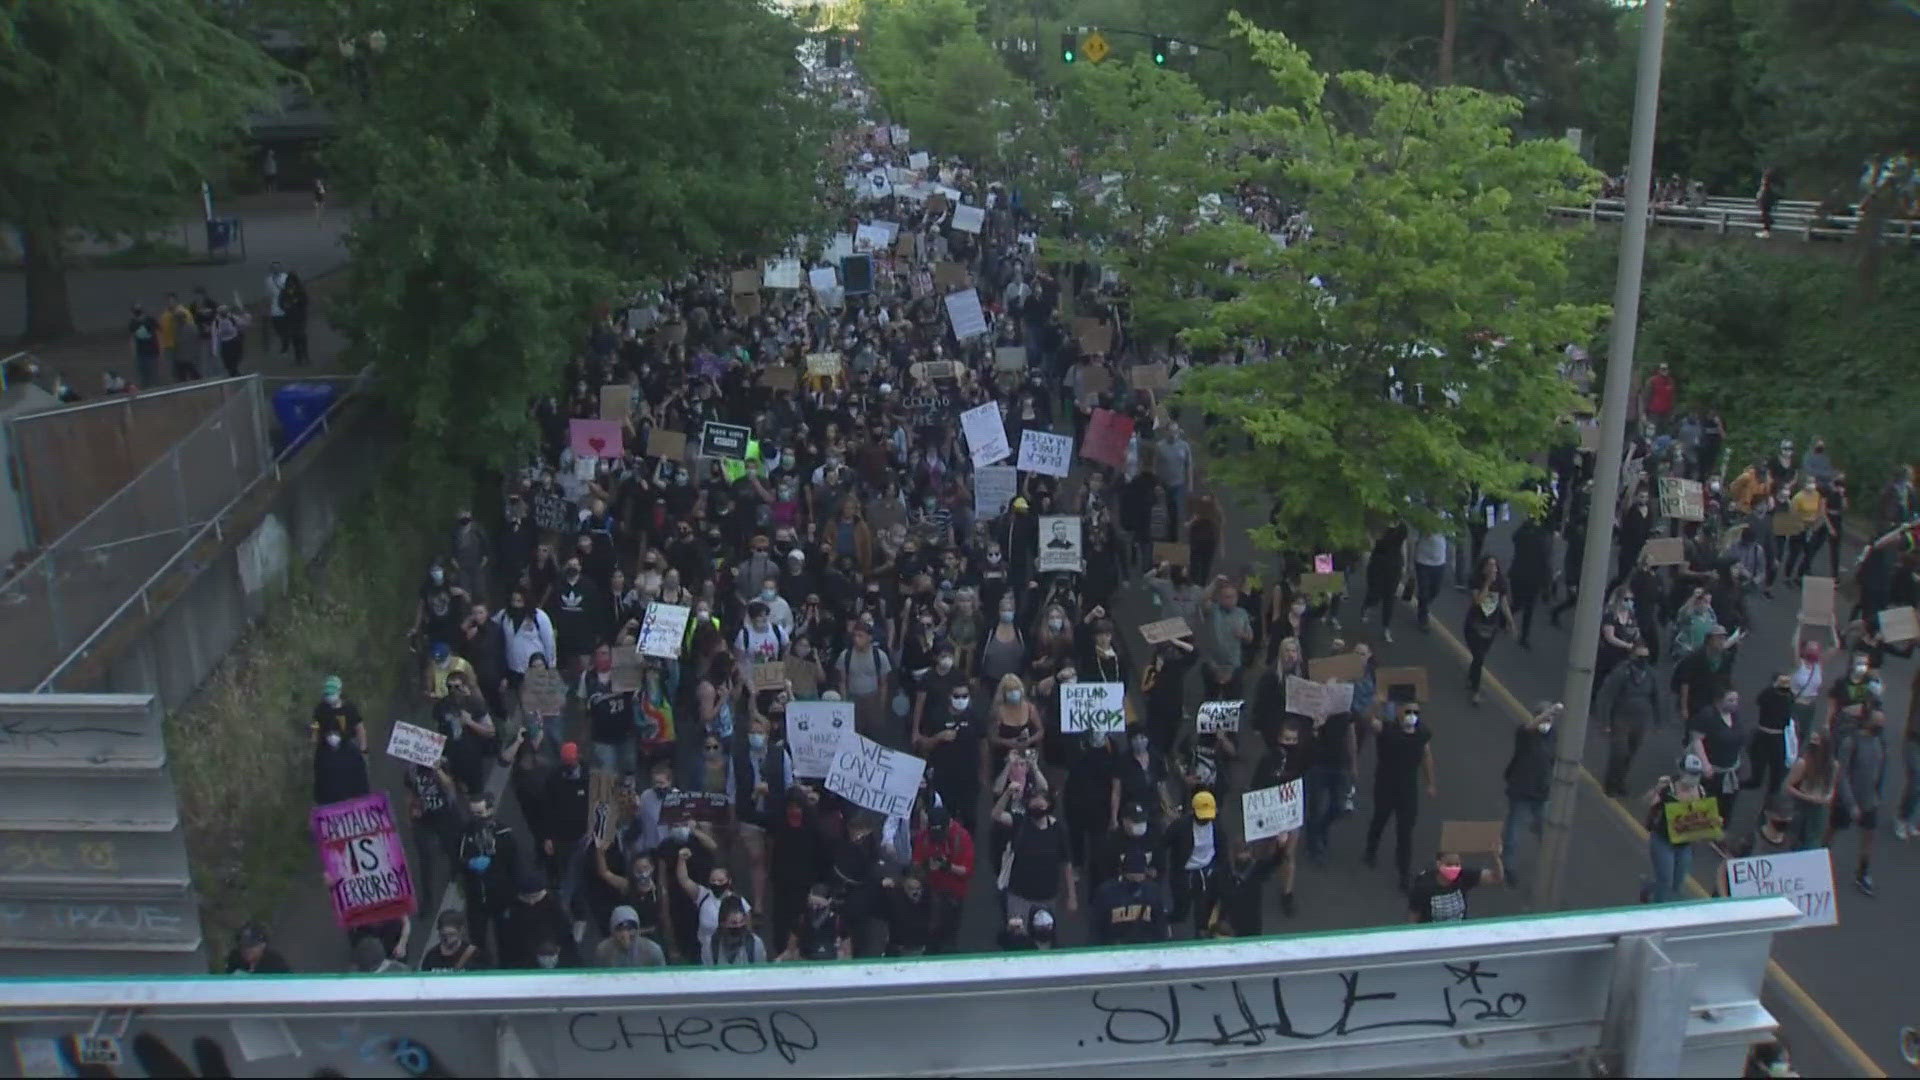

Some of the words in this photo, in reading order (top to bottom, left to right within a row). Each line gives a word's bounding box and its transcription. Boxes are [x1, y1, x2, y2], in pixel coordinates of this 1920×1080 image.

[1023, 431, 1068, 448] MATTER
[1027, 451, 1063, 469] BLACK
[1066, 686, 1109, 700] DEFUND
[840, 751, 892, 791] CAN'T
[859, 737, 895, 772] WE
[828, 773, 915, 816] BREATHE!
[317, 803, 393, 840] CAPITALISM
[347, 838, 380, 876] IS
[1733, 859, 1773, 884] END
[329, 863, 412, 915] TERRORISM
[1756, 877, 1806, 896] POLICE
